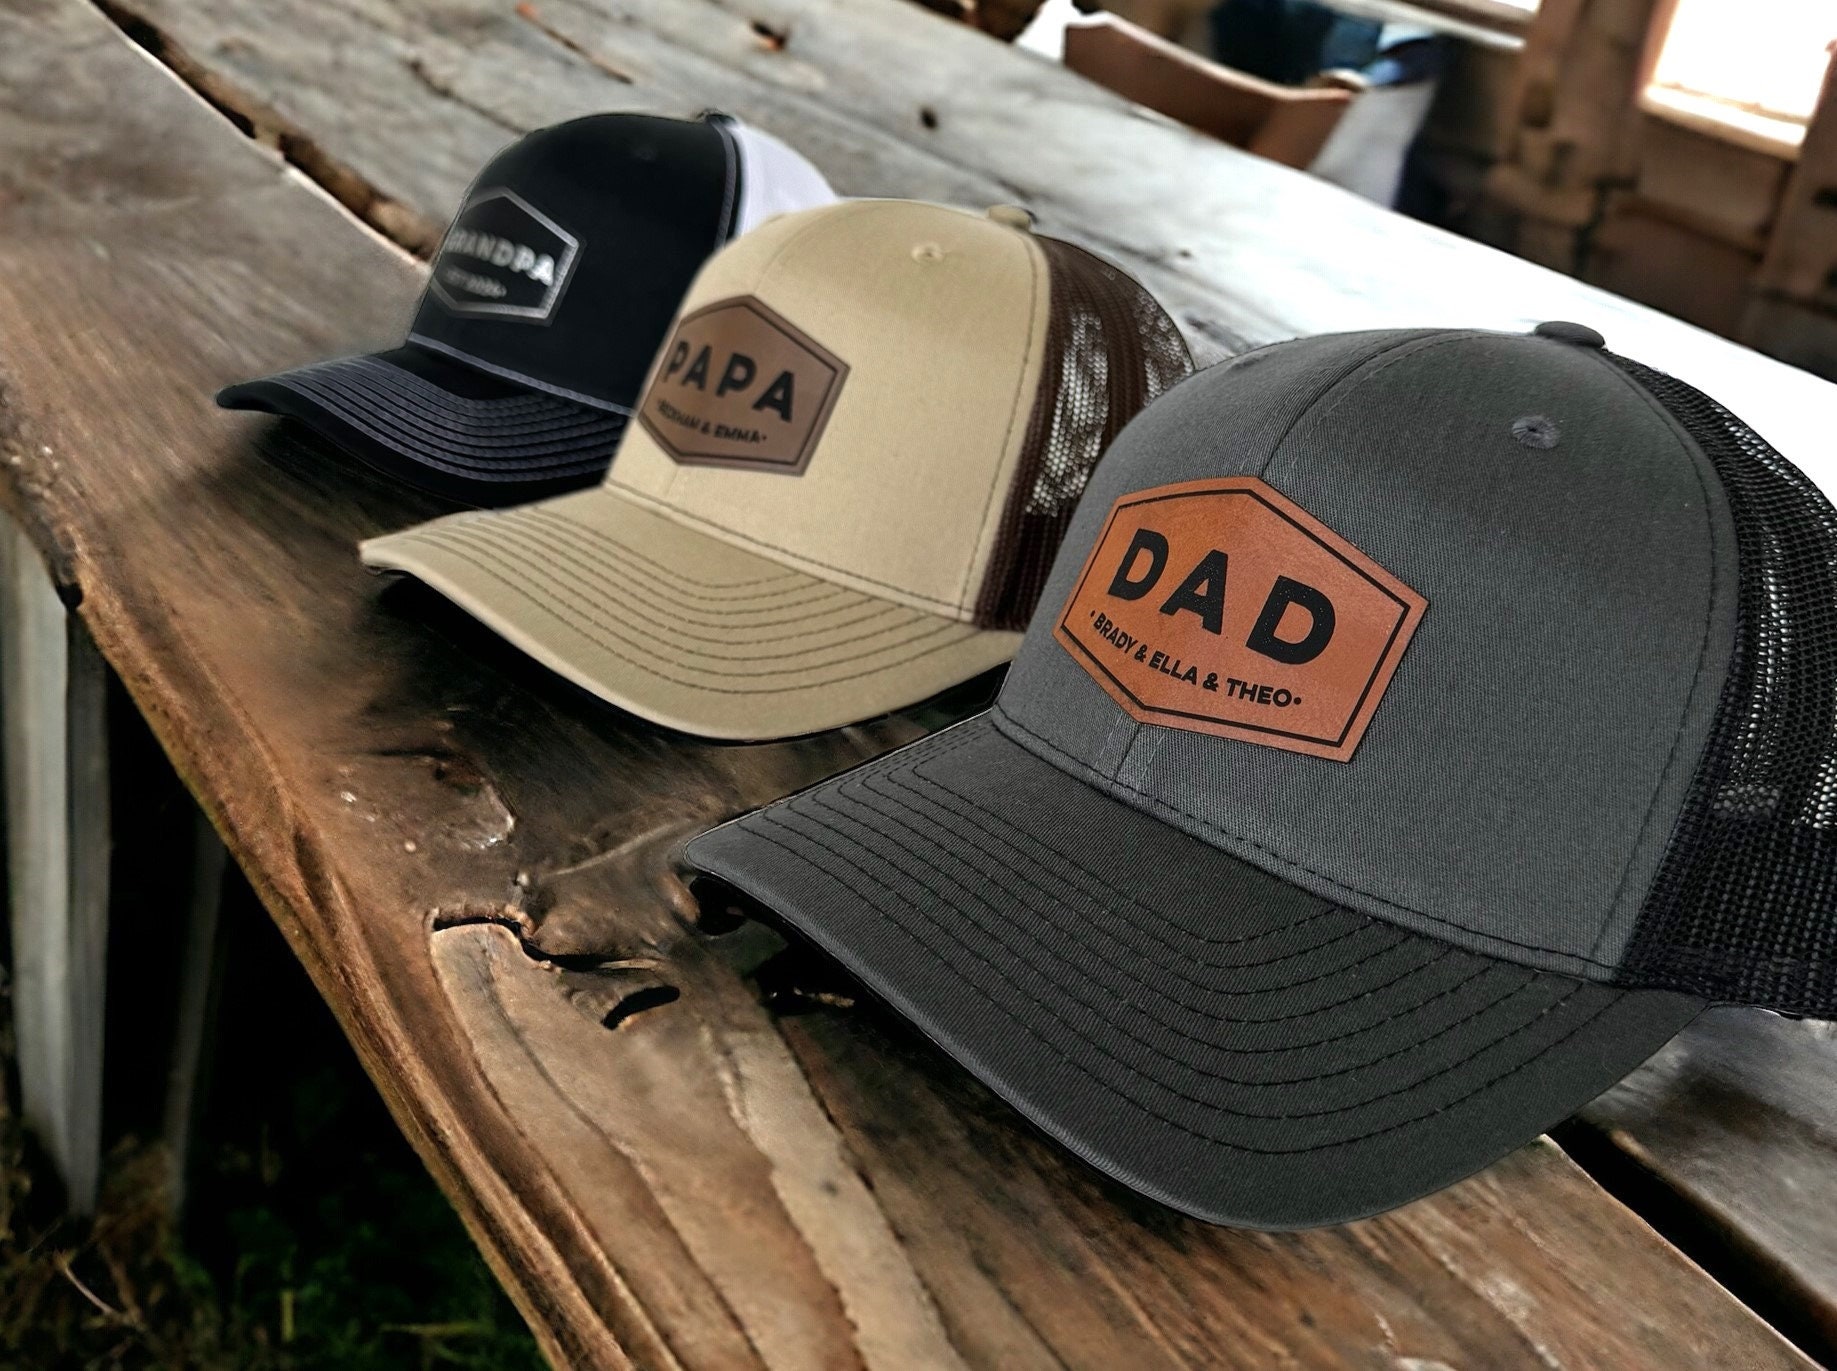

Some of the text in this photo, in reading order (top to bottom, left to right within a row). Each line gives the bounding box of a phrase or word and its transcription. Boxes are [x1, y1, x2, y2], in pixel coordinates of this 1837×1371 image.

[663, 340, 795, 424] PAPA
[1107, 528, 1336, 665] DAD
[1134, 644, 1147, 662] &
[1149, 651, 1198, 686] ELLA
[1202, 672, 1219, 692] &
